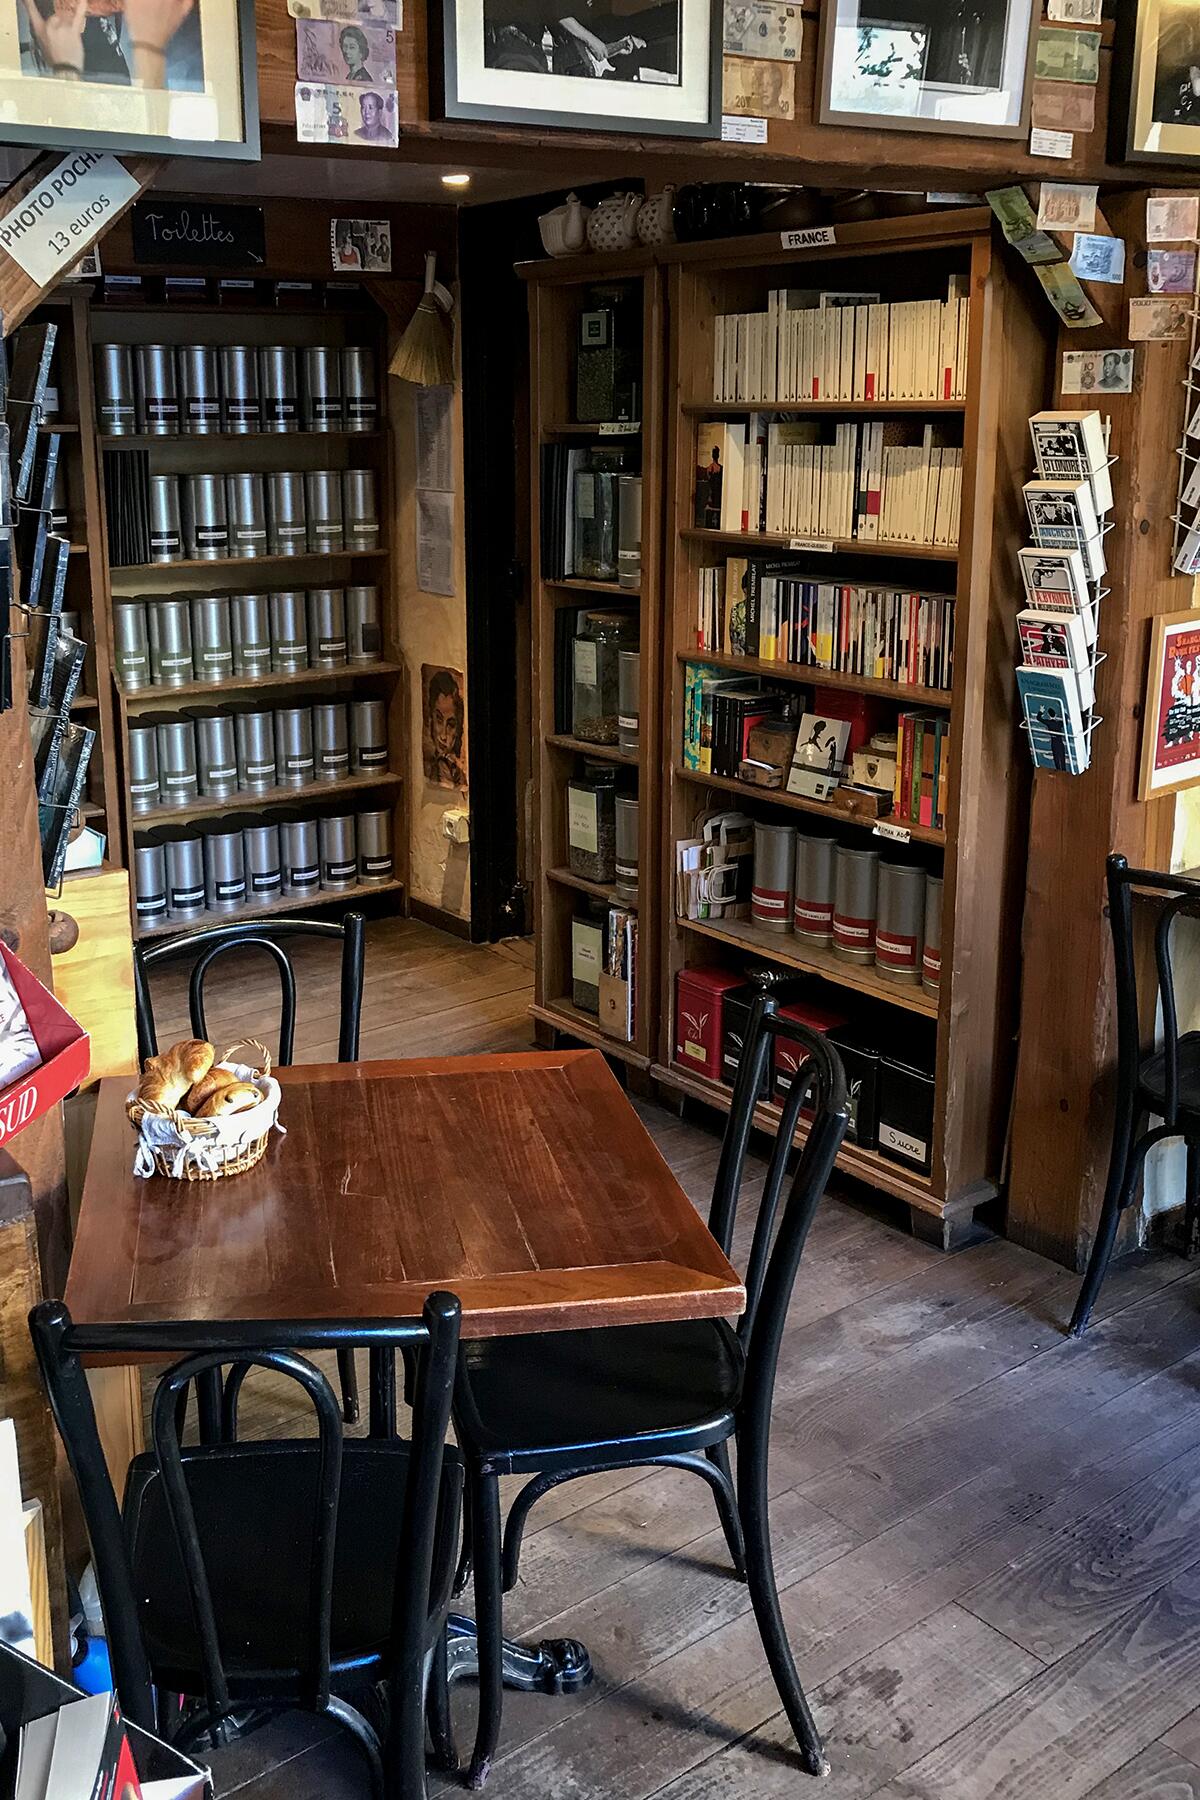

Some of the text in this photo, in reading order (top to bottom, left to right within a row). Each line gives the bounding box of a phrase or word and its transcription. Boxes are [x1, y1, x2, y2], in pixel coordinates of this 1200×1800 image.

[385, 30, 395, 43] 5
[0, 191, 55, 247] PHOTO
[48, 194, 110, 255] 13 euros
[145, 210, 234, 242] Toilettes
[788, 231, 830, 246] FRANCE
[1083, 361, 1094, 371] 10
[750, 563, 758, 597] TREMBLAY
[889, 1131, 921, 1155] Sucre
